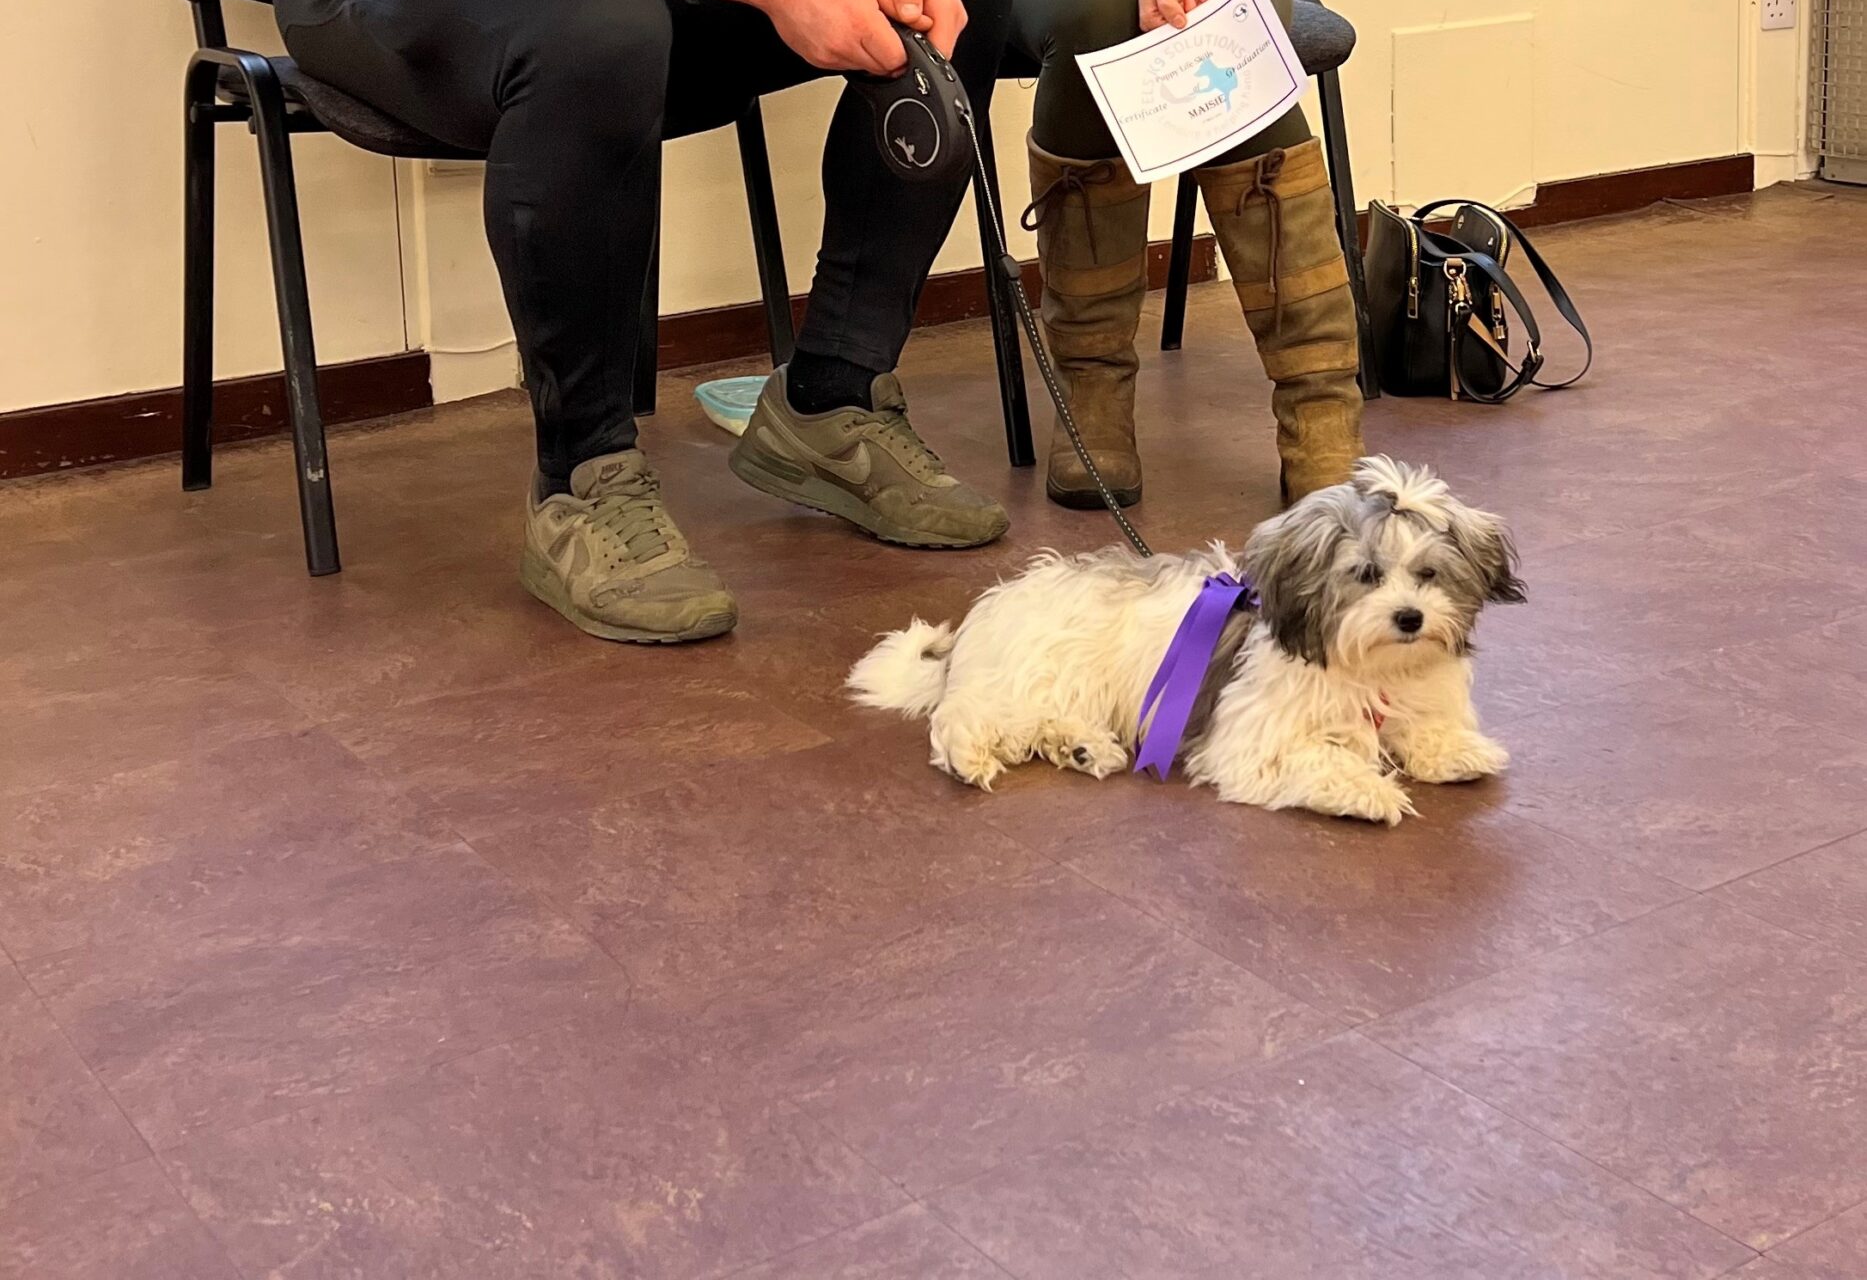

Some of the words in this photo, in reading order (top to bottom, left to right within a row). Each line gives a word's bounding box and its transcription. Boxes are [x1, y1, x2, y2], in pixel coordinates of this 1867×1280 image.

[1149, 56, 1167, 77] K9
[1164, 33, 1247, 60] SOLUTIONS
[1225, 39, 1272, 79] Graduation
[1118, 102, 1168, 126] Certificate
[1187, 93, 1228, 120] MAISIE
